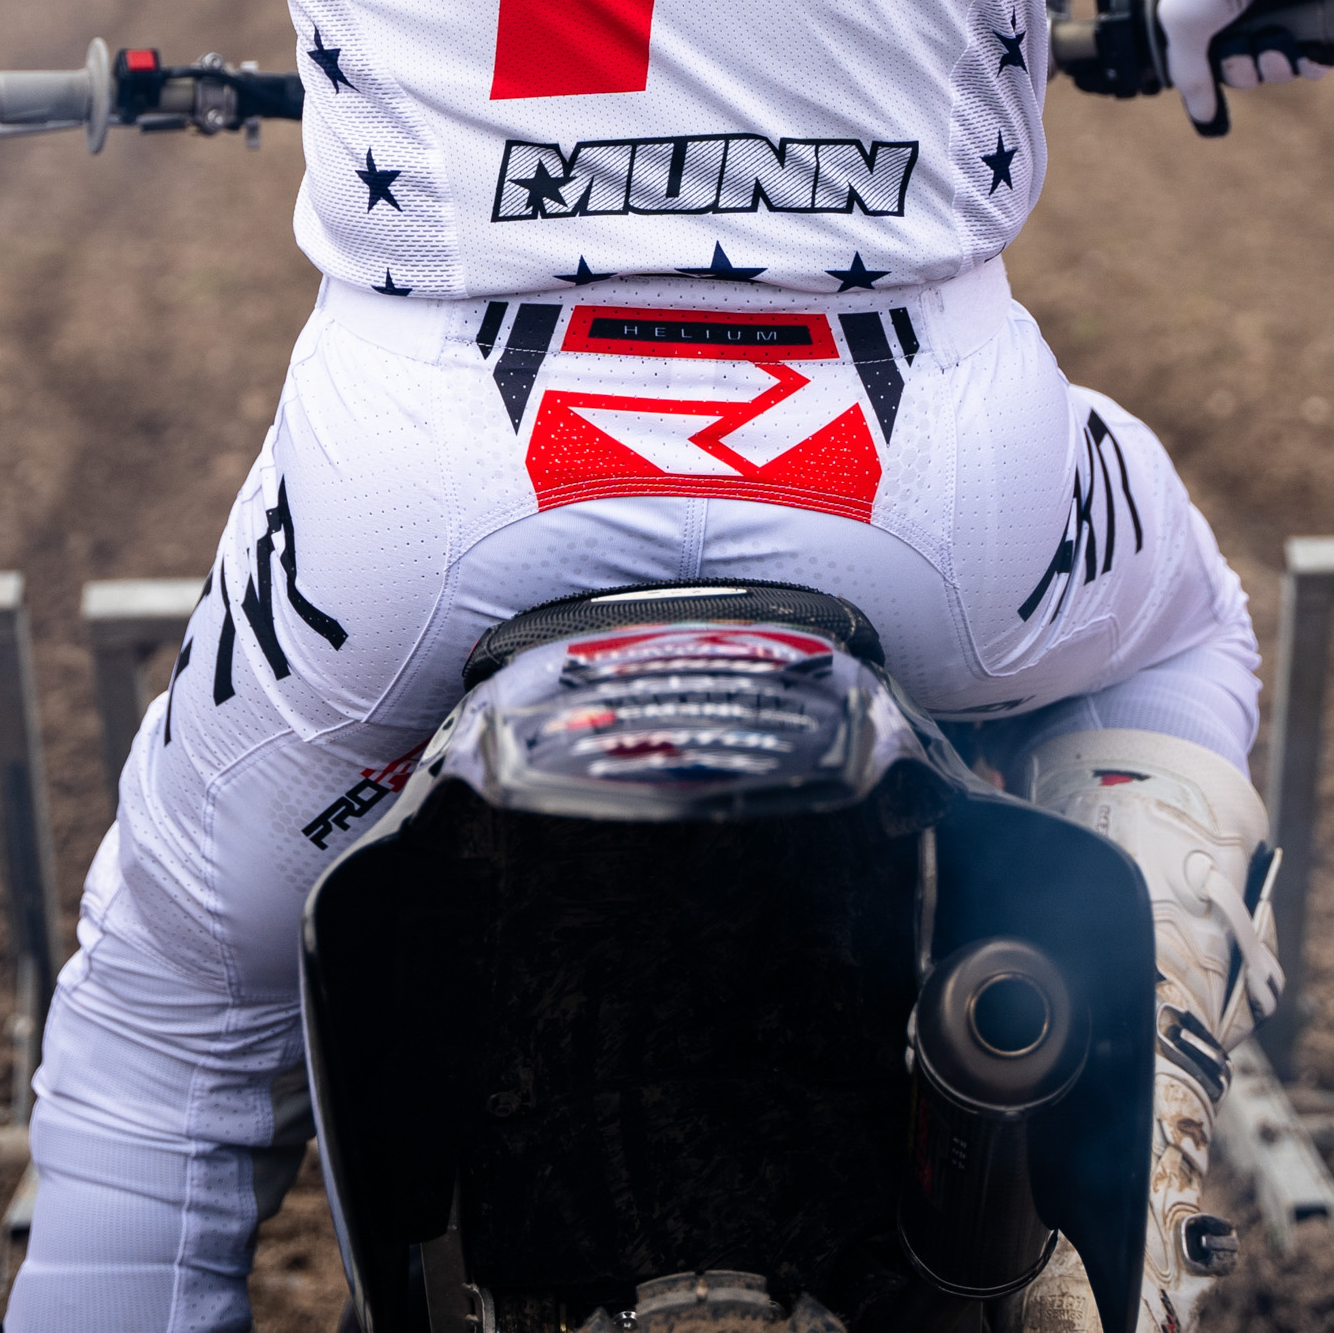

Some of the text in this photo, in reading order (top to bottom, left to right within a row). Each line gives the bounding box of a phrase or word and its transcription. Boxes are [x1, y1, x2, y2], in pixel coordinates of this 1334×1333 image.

[491, 132, 920, 223] MUNN
[622, 324, 780, 343] HELIUM
[301, 776, 391, 851] PRO
